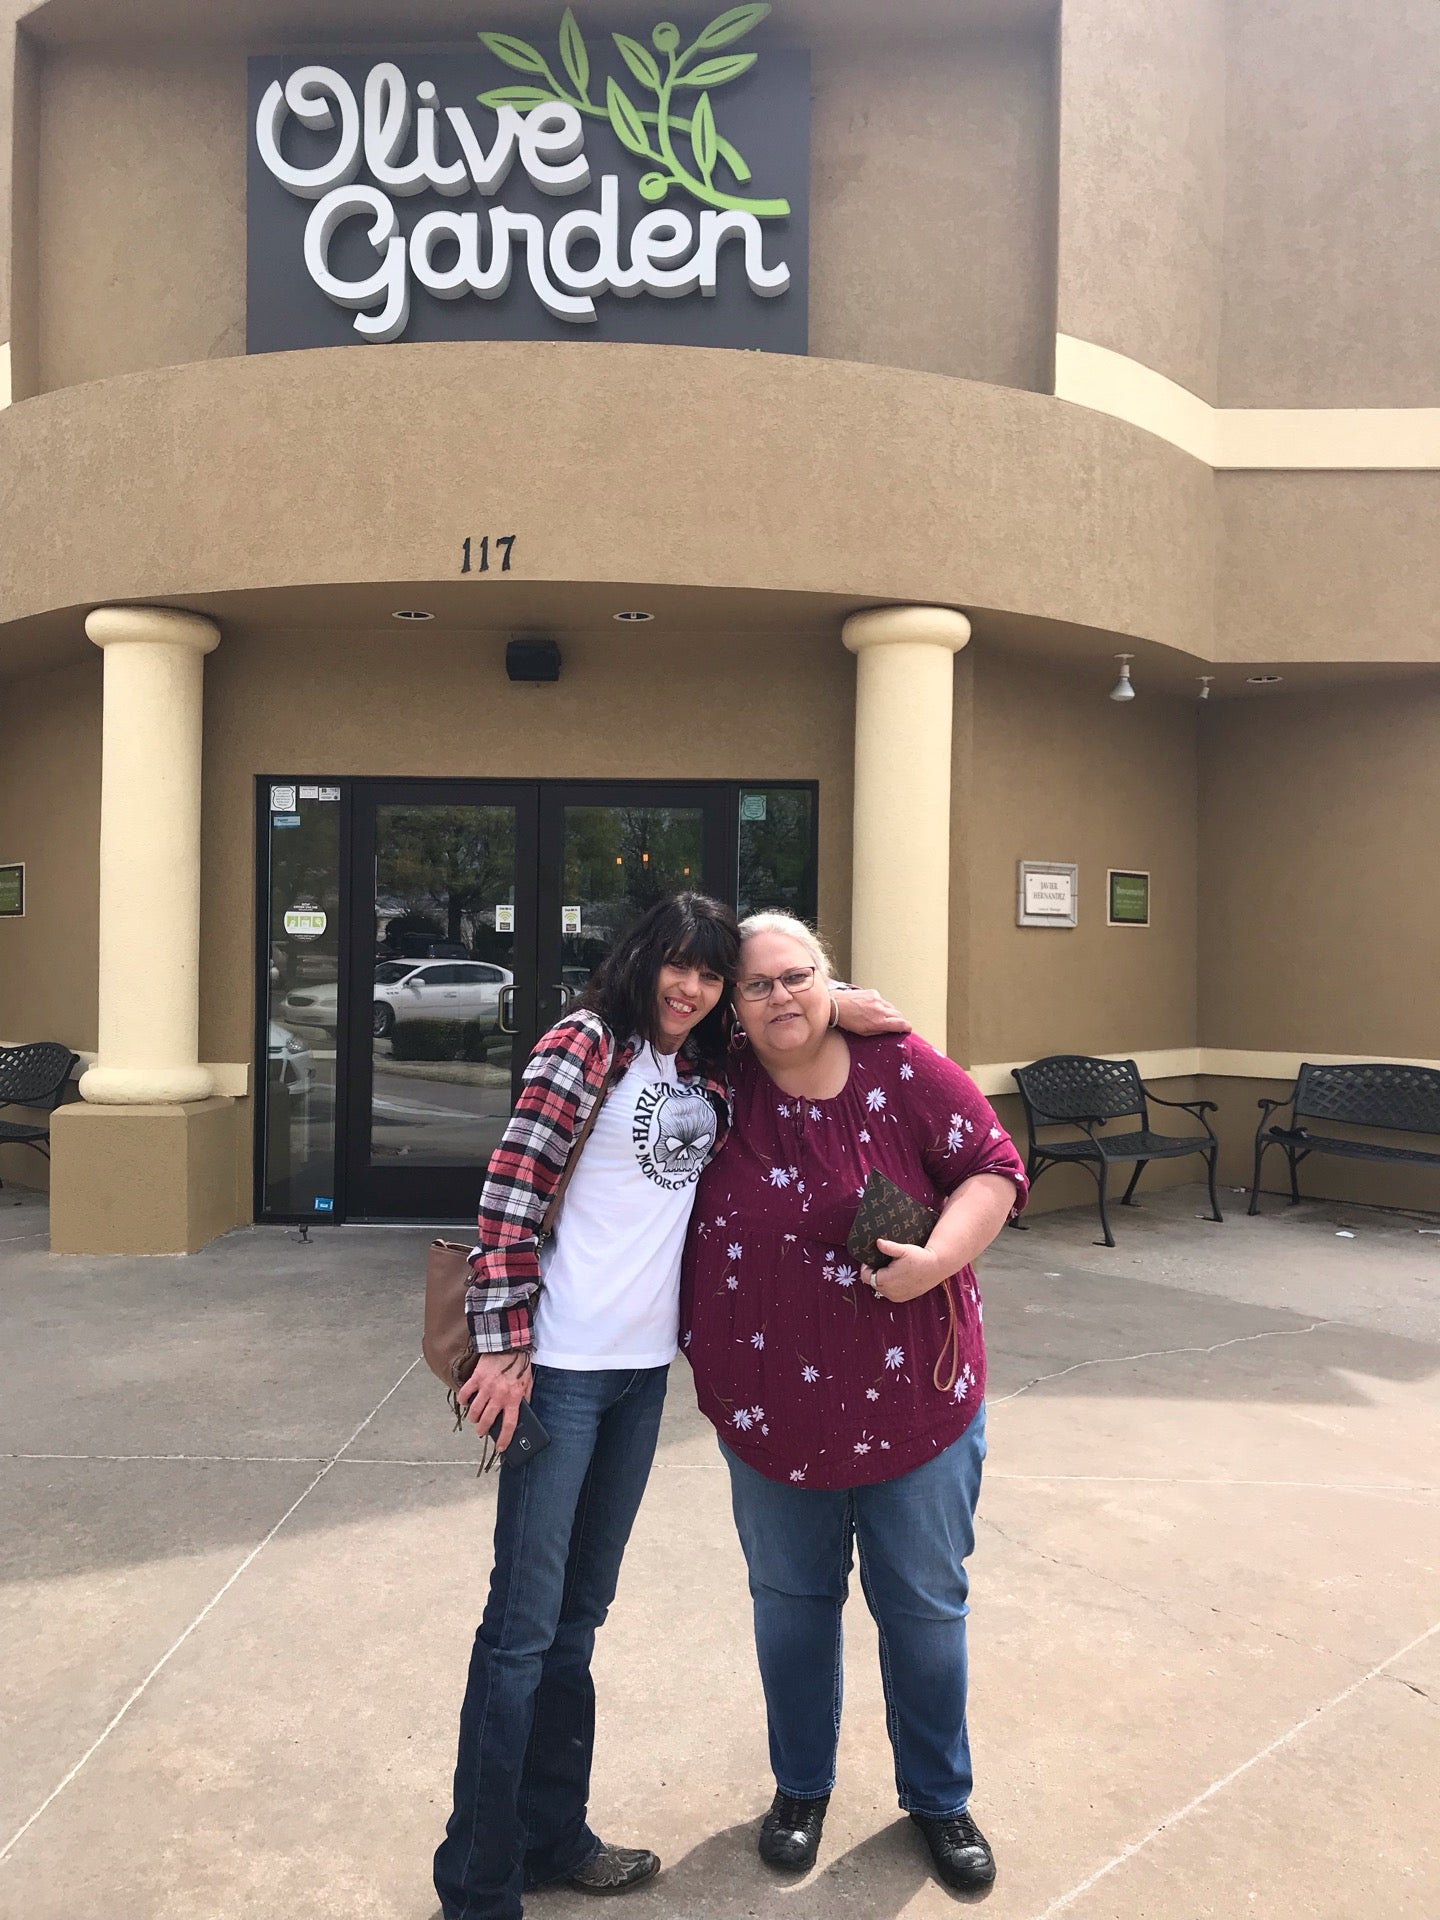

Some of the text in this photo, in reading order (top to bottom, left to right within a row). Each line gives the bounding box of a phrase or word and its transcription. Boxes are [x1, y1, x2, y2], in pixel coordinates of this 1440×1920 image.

[256, 62, 592, 198] Olive
[303, 174, 791, 343] Garden
[461, 534, 516, 574] 117
